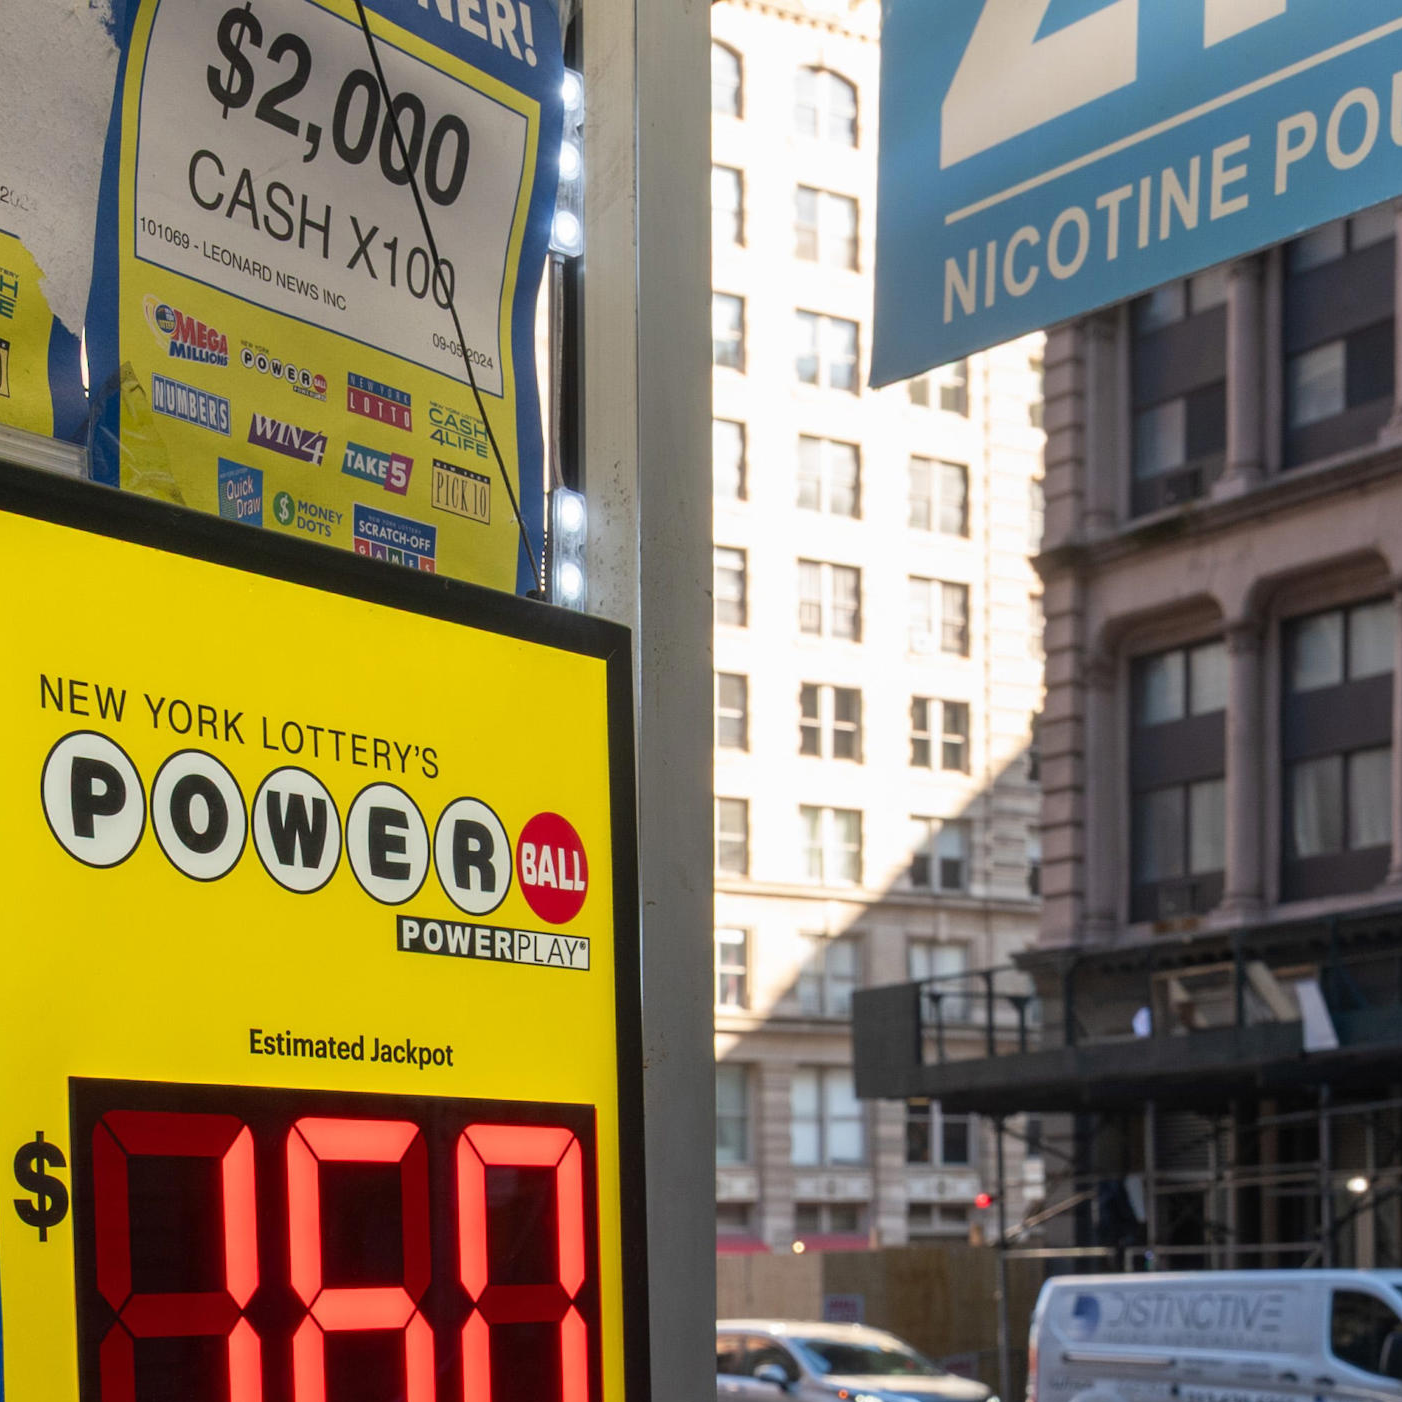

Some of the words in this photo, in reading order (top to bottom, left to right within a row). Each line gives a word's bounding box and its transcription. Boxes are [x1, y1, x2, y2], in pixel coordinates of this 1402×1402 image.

[206, 1, 471, 207] $2,000
[188, 149, 332, 259] CASH
[346, 214, 456, 310] X100
[942, 135, 1253, 325] NICOTINE
[139, 216, 190, 250] 101069
[202, 239, 272, 284] LEONARD
[276, 271, 320, 302] NEWS
[323, 287, 347, 311] INC
[168, 341, 230, 367] MILLIONS
[172, 309, 229, 355] MEGA
[154, 379, 229, 431] NUMBERS
[350, 391, 411, 428] LOTTO
[429, 407, 489, 441] CASH
[429, 428, 489, 459] 4LIFE
[226, 475, 254, 501] Quick
[237, 496, 262, 520] Draw
[435, 470, 469, 515] PICK
[472, 484, 488, 519] 10
[297, 499, 343, 526] MONEY
[297, 516, 333, 538] DOTS
[358, 520, 432, 552] SCRATCH-OFF
[39, 673, 127, 723] NEW
[144, 692, 246, 745] YORK
[249, 1026, 365, 1063] Estimated
[370, 1036, 454, 1071] Jackpot
[12, 1130, 70, 1243] $
